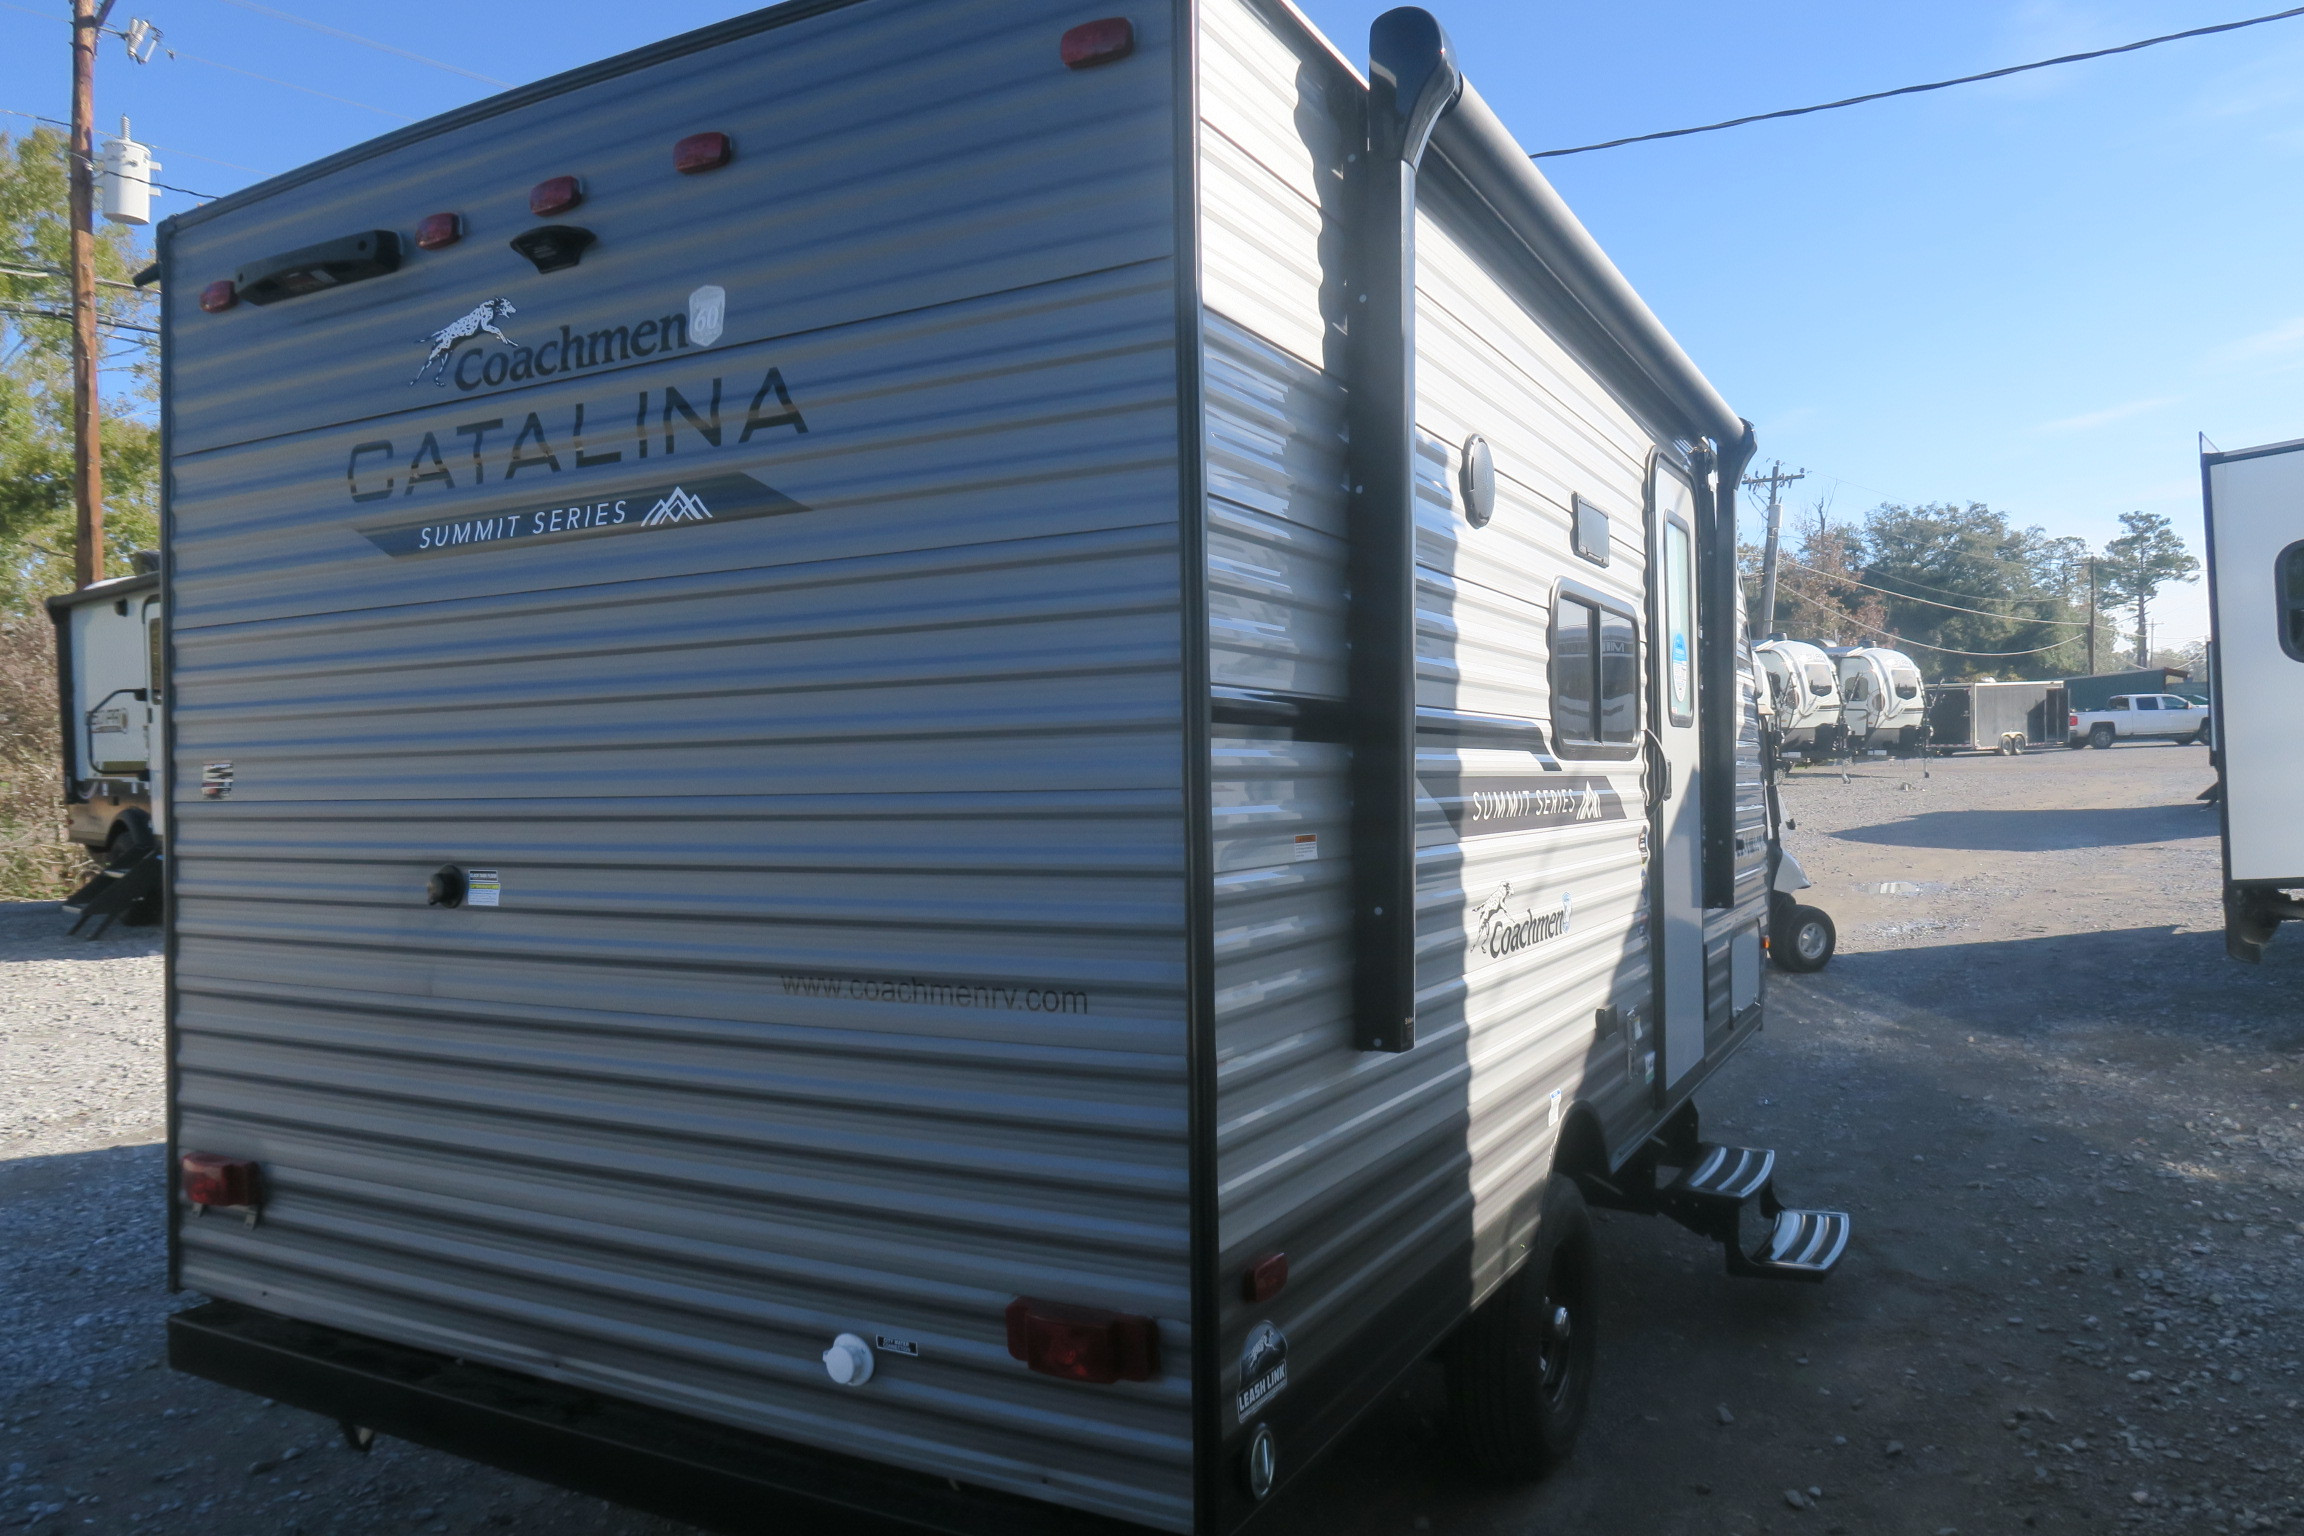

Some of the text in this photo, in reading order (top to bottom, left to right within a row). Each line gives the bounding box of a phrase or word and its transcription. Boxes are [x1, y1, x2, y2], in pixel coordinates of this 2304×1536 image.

[453, 311, 689, 392] Coachmen
[346, 366, 810, 503] CATALINA
[419, 500, 626, 549] SUMMIT SERIES
[1472, 788, 1575, 821] SUMMIT SERIES
[1489, 908, 1565, 959] Coachmen
[780, 975, 1089, 1015] www.coachmenrv.com
[1238, 1378, 1266, 1412] LEASH
[1266, 1363, 1285, 1390] LINK
